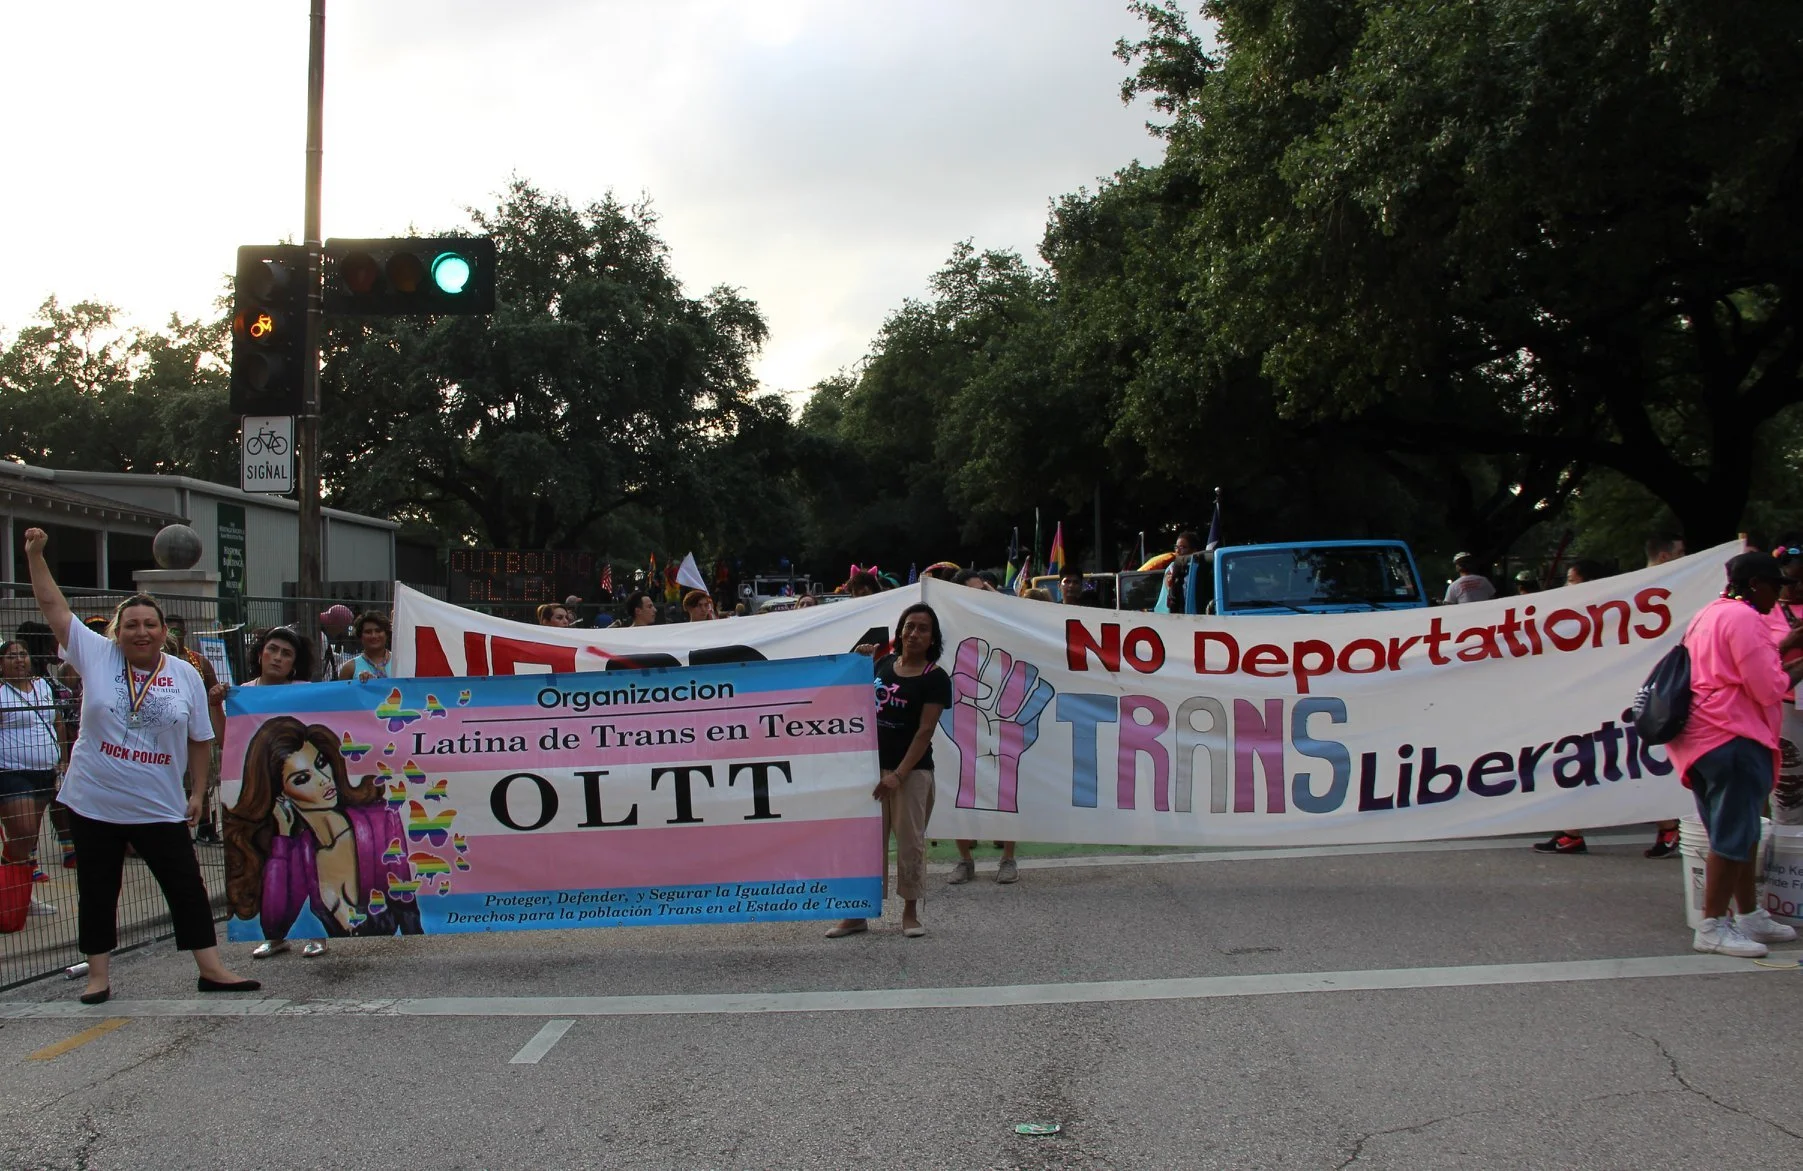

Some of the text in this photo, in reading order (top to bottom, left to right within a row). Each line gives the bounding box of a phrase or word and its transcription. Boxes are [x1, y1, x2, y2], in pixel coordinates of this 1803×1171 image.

[246, 464, 288, 480] SIGNAL
[470, 579, 557, 601] ALLEN
[1065, 587, 1673, 694] NO Deportations
[537, 680, 734, 712] Organizacion
[412, 731, 528, 756] Latina
[539, 727, 580, 750] de
[591, 724, 696, 748] Trans
[706, 723, 749, 741] en
[759, 714, 865, 738] Texas
[100, 741, 172, 765] FUCK POLICE
[1055, 692, 1352, 815] TRANS
[490, 761, 793, 831] OLTT
[485, 882, 828, 908] Proteger, Defender, y Segurar la Igualdad de
[446, 897, 872, 924] Derechos para la población Trans en el Estado de Texas.
